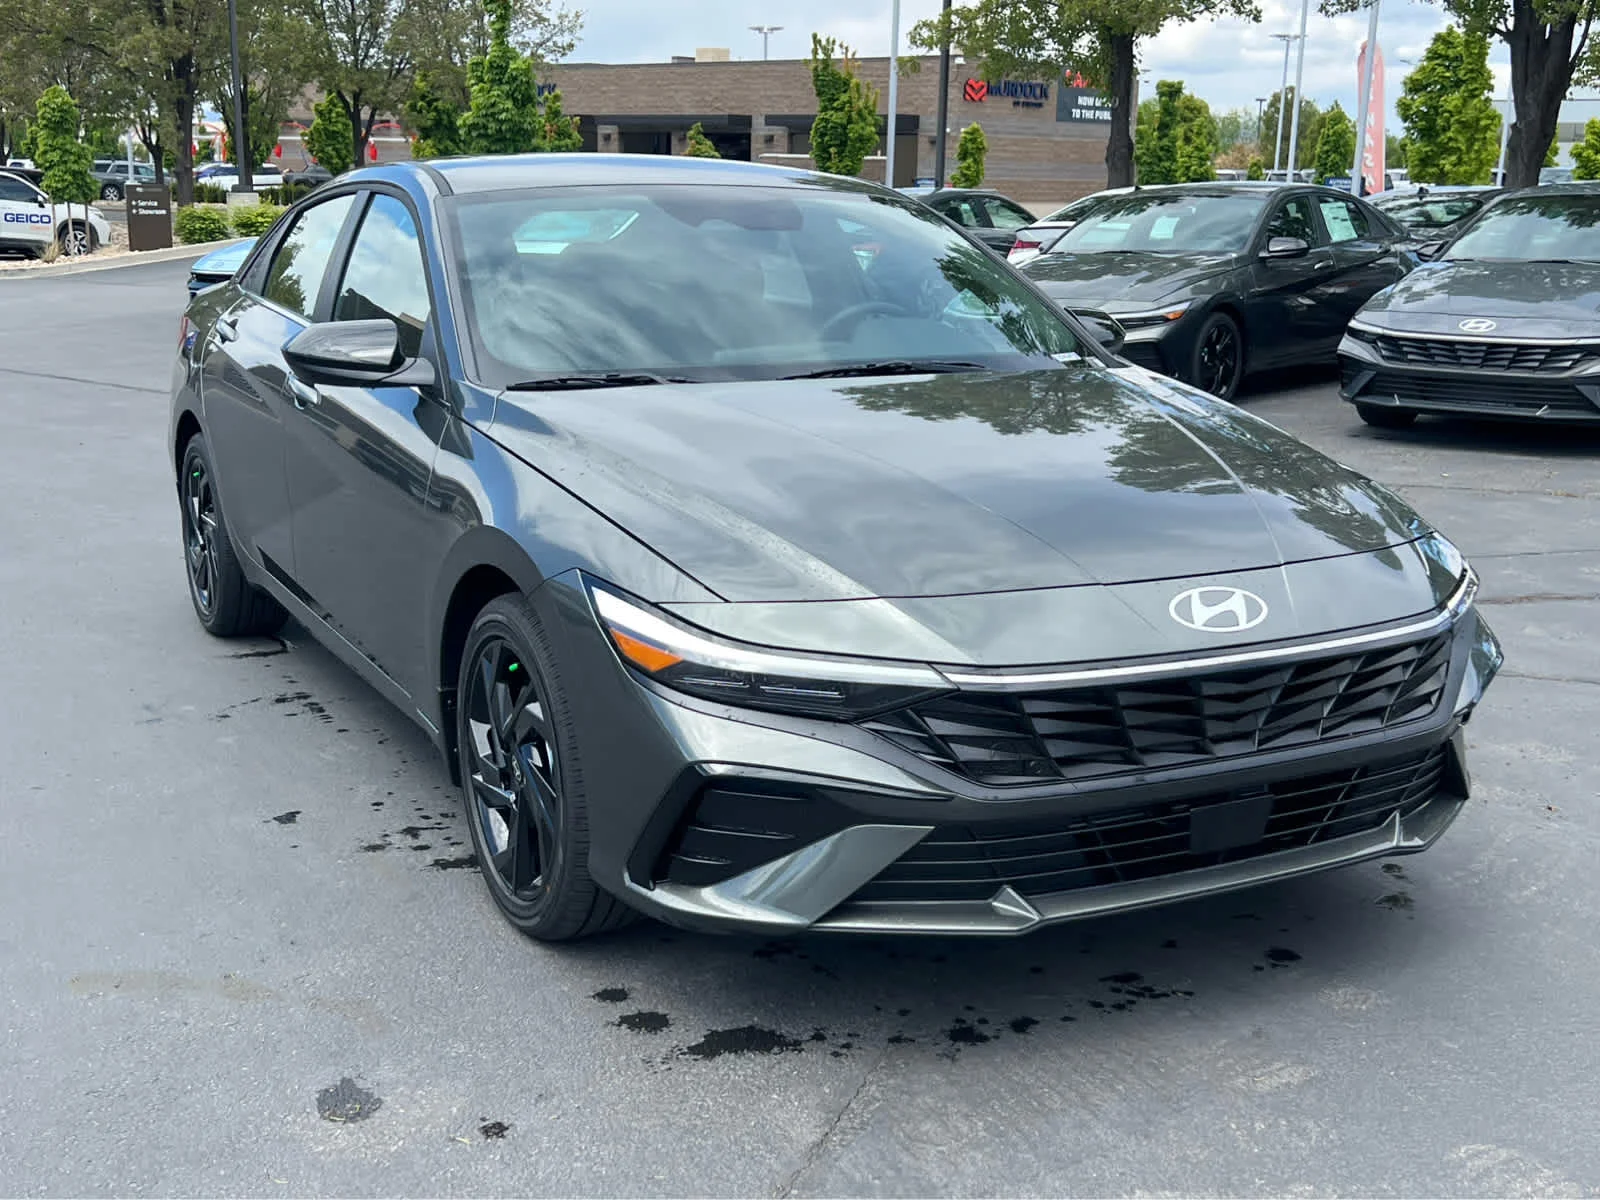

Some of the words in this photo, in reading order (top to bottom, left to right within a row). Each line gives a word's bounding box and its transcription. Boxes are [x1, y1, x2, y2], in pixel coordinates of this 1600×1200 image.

[1082, 109, 1094, 119] THE
[1095, 110, 1112, 121] PUBL
[4, 213, 51, 224] GEICO
